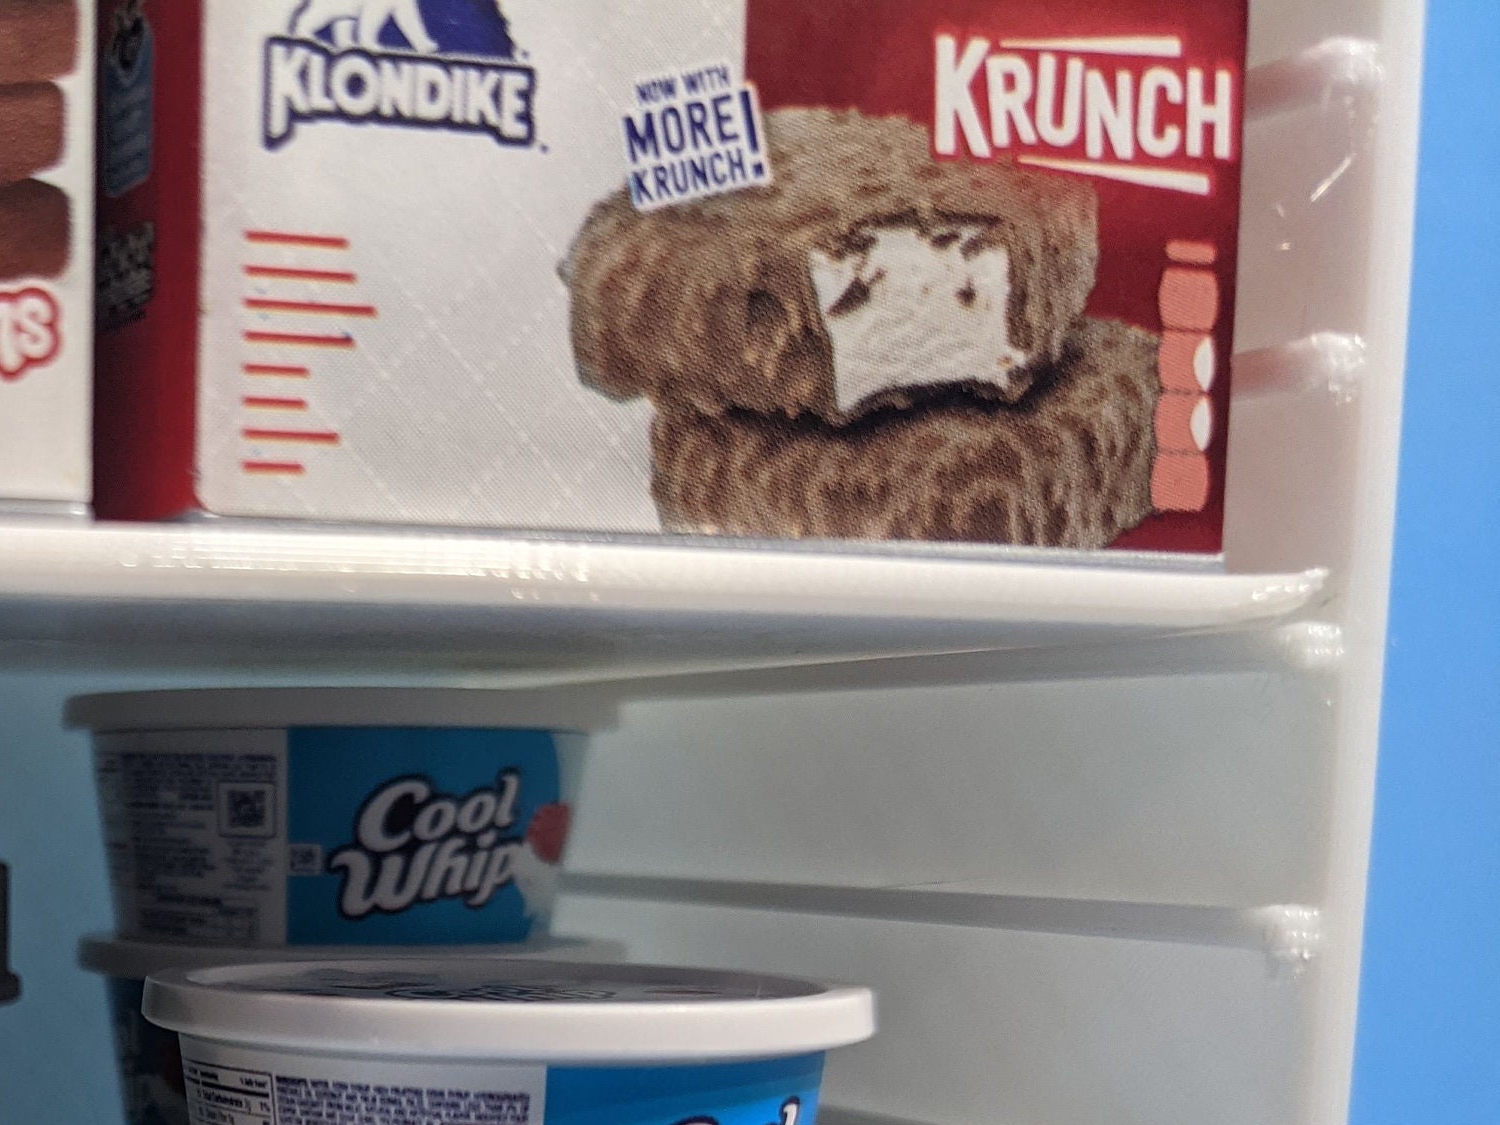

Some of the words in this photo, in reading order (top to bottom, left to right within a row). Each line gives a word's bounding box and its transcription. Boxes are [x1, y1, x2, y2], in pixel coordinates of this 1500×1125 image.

[263, 38, 536, 150] KLONDIKE
[635, 78, 677, 104] NOW
[682, 66, 730, 95] WITH
[932, 32, 1235, 161] KRUNCH
[354, 769, 521, 853] Cool
[330, 833, 527, 918] Whip
